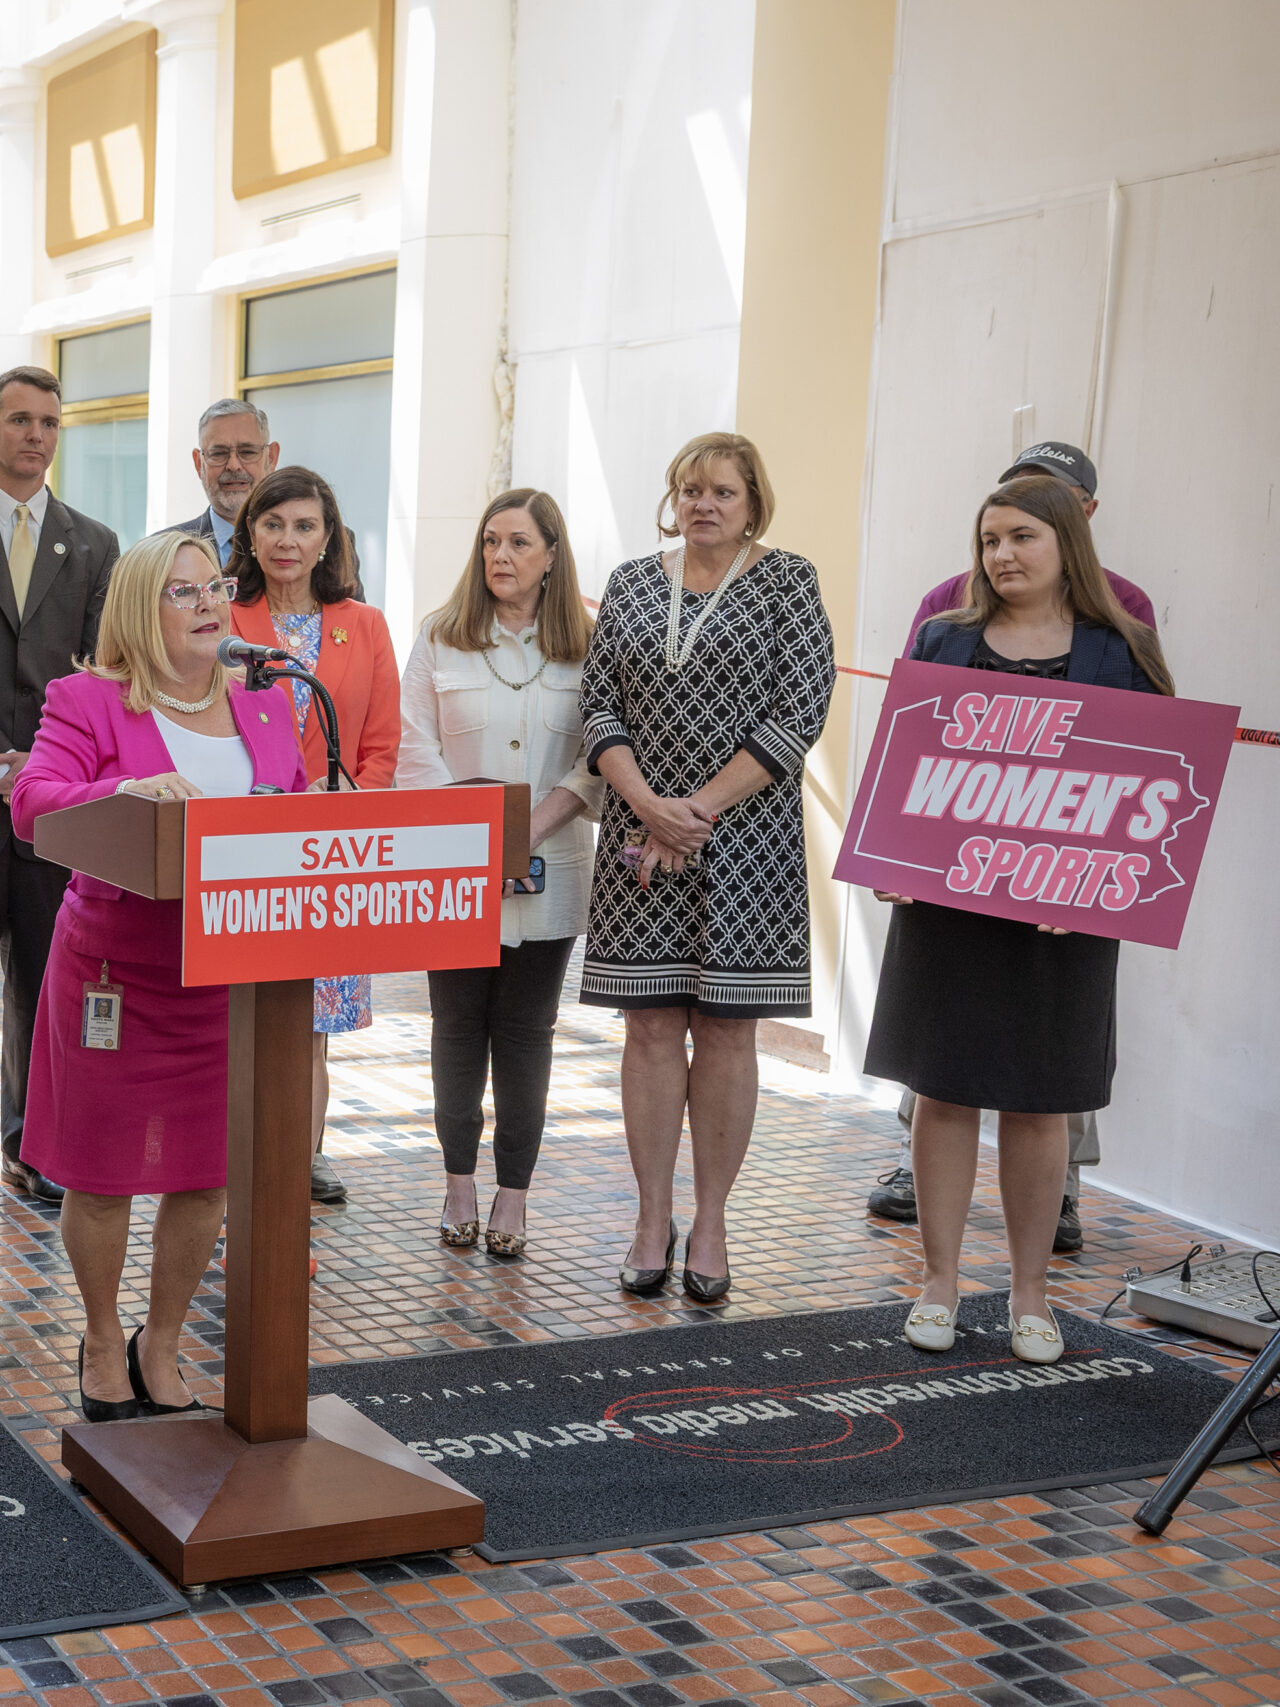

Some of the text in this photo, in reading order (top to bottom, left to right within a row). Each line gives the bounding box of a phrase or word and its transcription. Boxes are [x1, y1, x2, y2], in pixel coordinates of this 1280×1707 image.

[941, 692, 1083, 758] SAVE
[900, 754, 1181, 843] WOMEN'S
[300, 834, 394, 871] SAVE
[945, 836, 1150, 911] SPORTS
[200, 877, 488, 935] WOMEN'S SPORTS ACT
[561, 1357, 731, 1383] GENERAL
[763, 1348, 803, 1360] OF
[406, 1357, 1153, 1462] commonwealth media services
